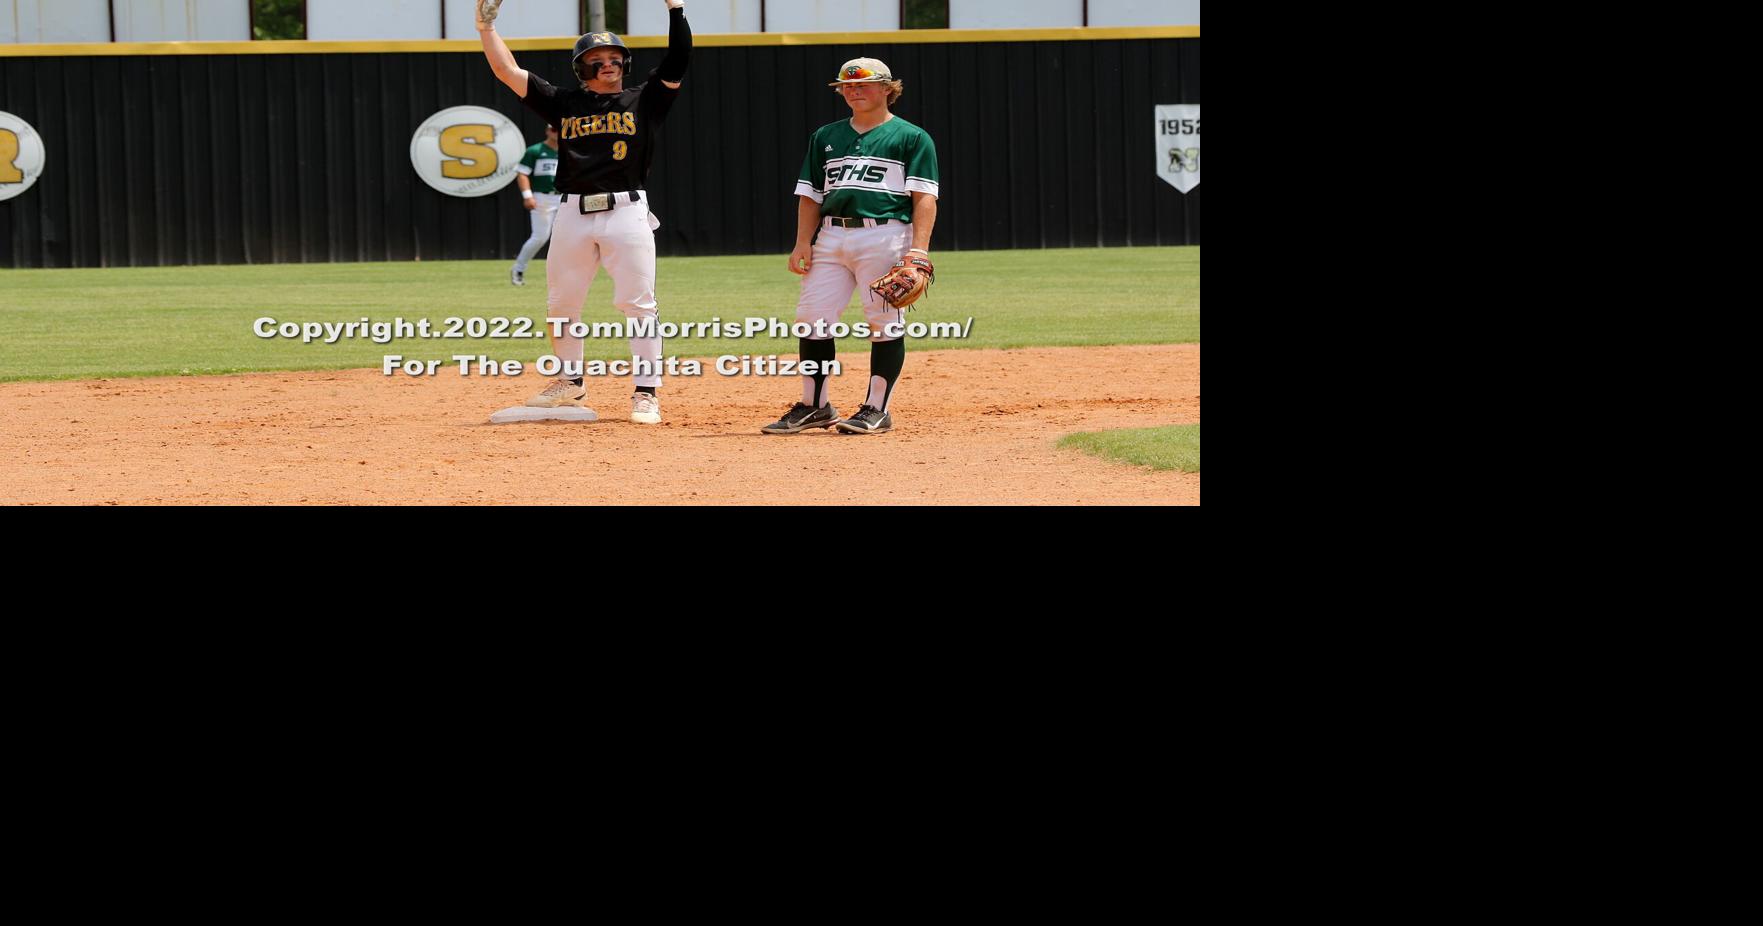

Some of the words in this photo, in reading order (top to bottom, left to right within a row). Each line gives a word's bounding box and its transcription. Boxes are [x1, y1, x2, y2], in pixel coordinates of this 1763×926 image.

[561, 111, 636, 139] TIGERS
[439, 123, 499, 180] S
[612, 140, 628, 161] 9
[826, 164, 888, 185] STHS
